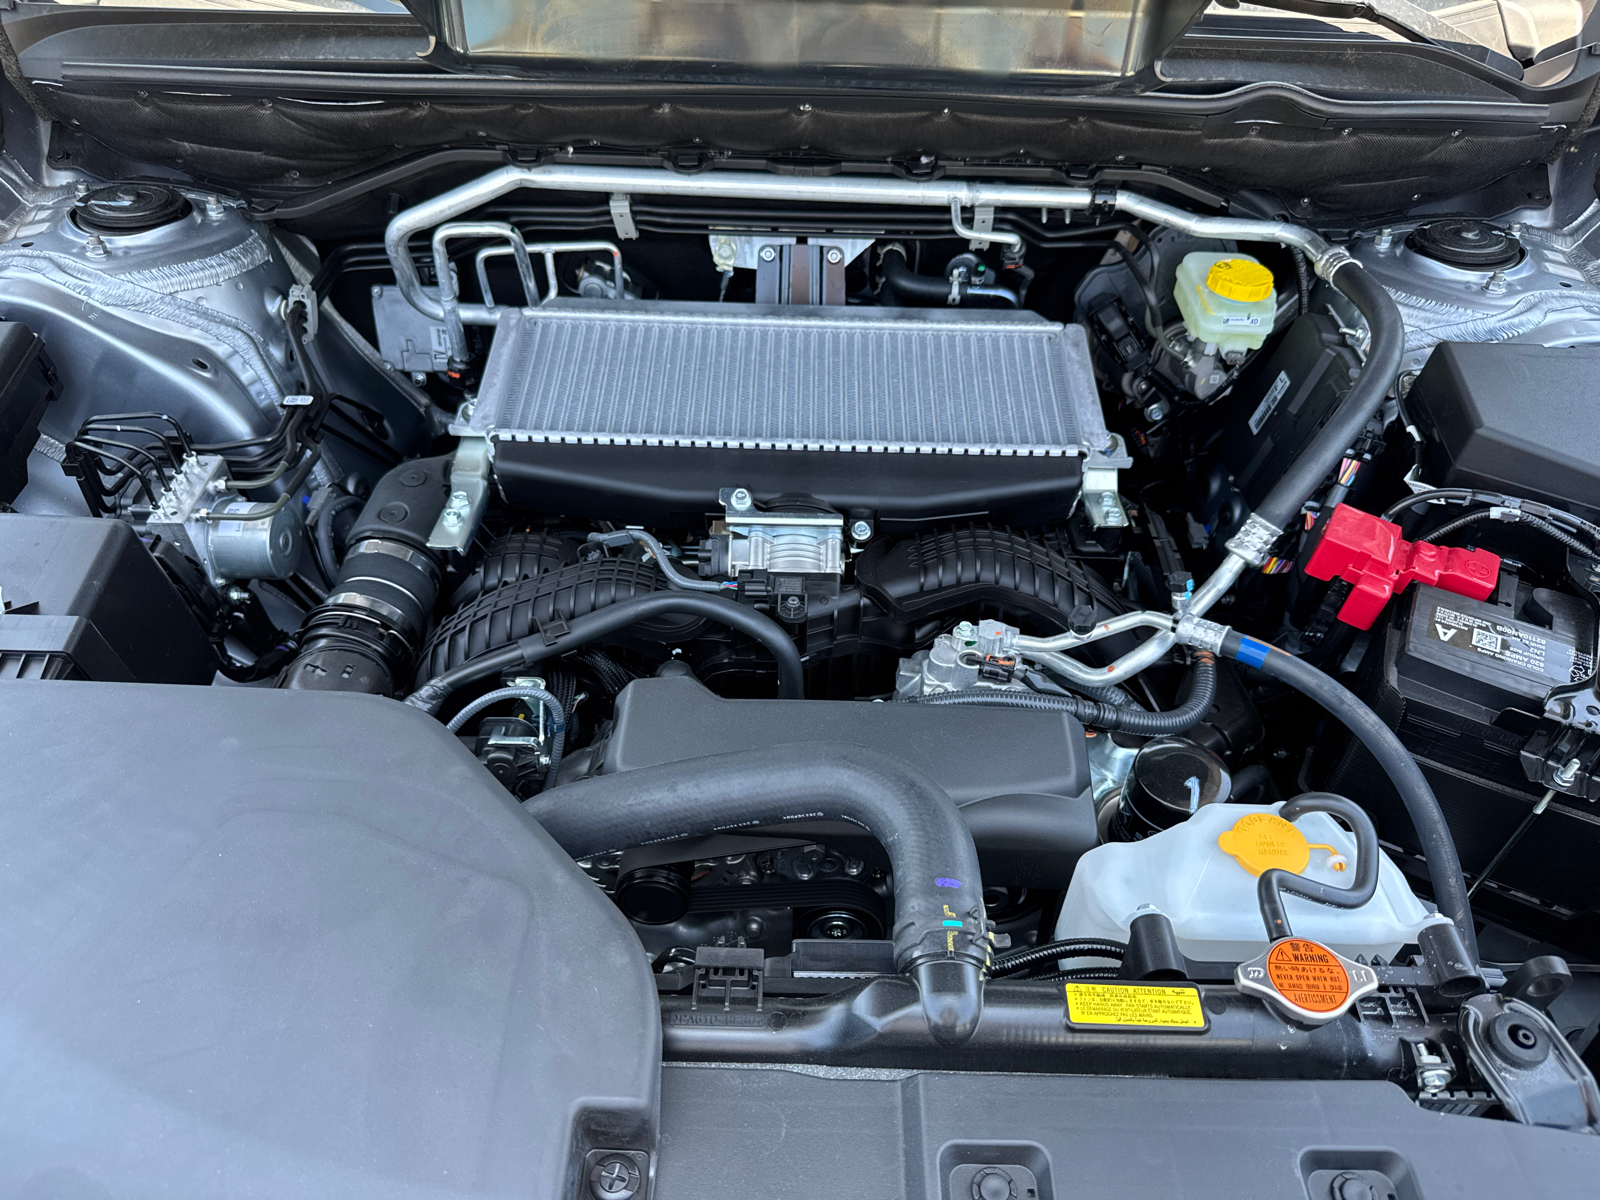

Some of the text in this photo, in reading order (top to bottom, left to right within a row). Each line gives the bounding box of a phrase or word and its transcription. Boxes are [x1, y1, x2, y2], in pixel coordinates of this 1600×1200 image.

[1435, 623, 1458, 642] A
[1529, 648, 1545, 656] LN2
[1527, 664, 1544, 672] COLD
[1236, 815, 1297, 834] COOLANT
[1292, 953, 1329, 963] WARNING
